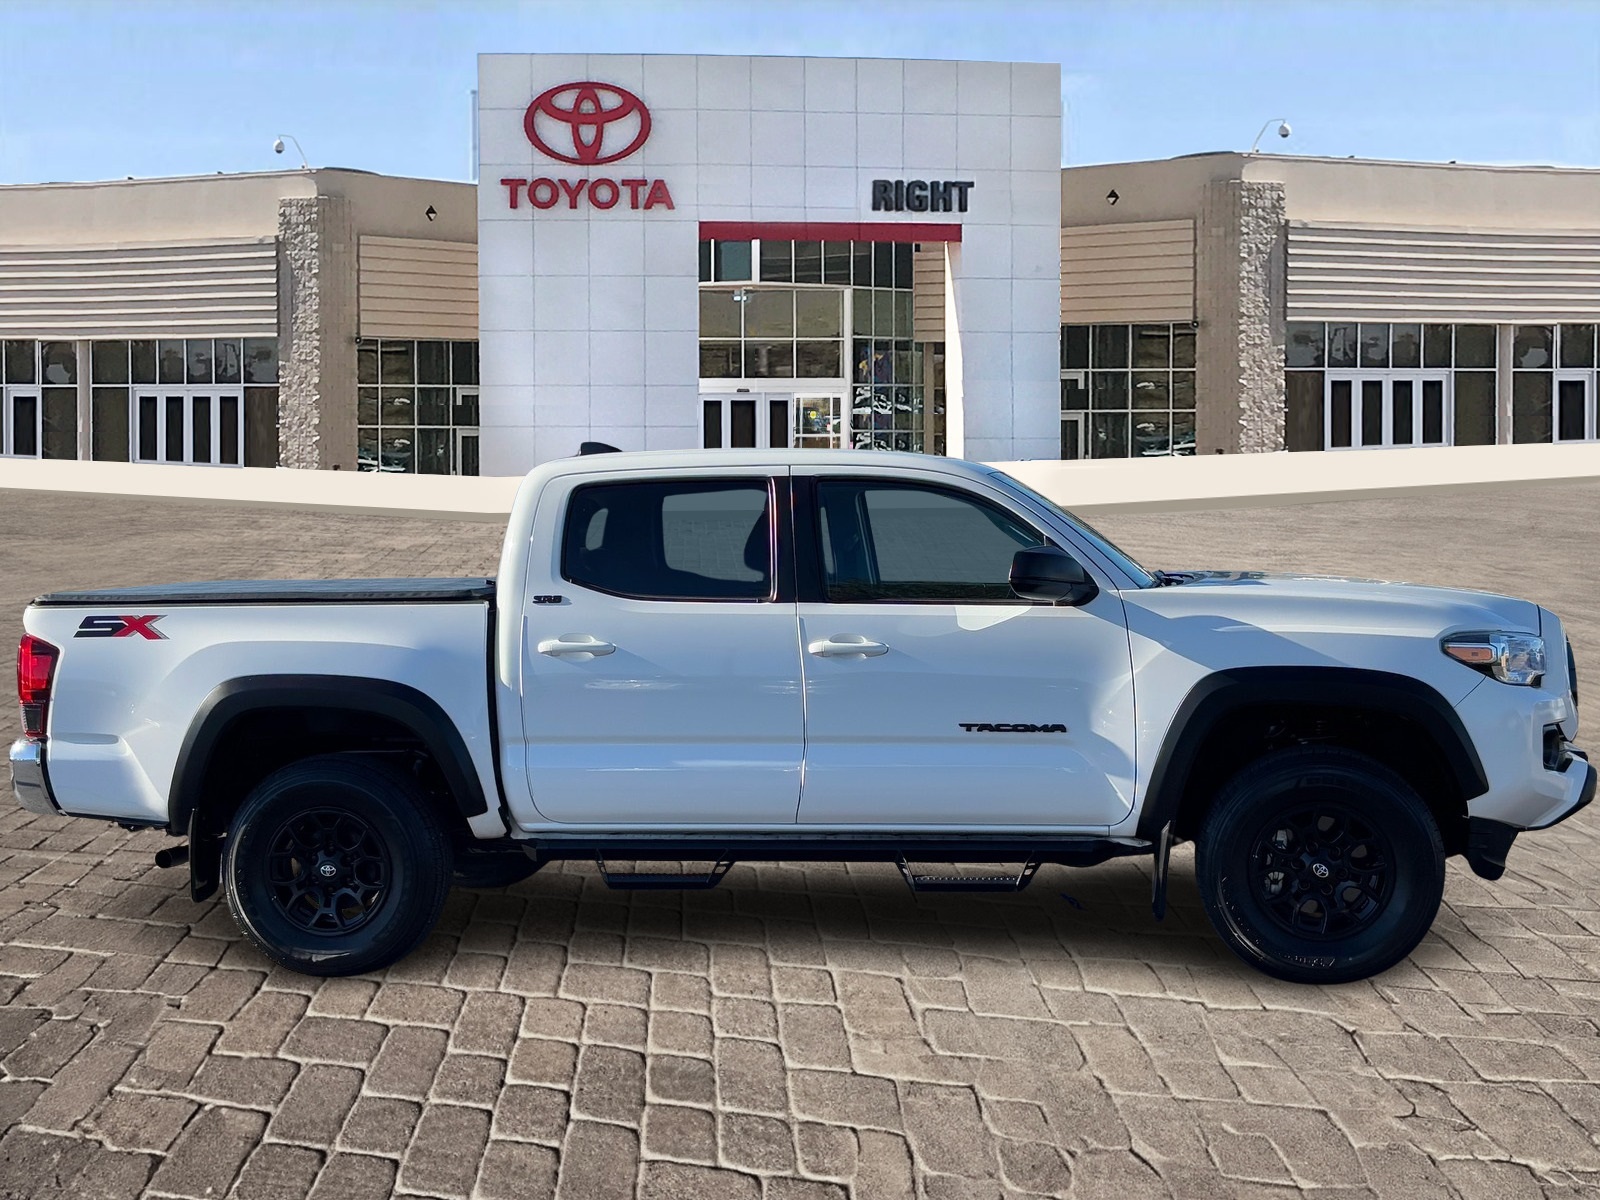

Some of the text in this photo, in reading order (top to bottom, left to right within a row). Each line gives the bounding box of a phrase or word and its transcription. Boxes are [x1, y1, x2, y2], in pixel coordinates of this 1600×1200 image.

[500, 178, 675, 209] TOYOTA
[871, 179, 974, 212] RIGHT
[73, 615, 170, 640] SX
[958, 723, 1067, 733] TACOMA
